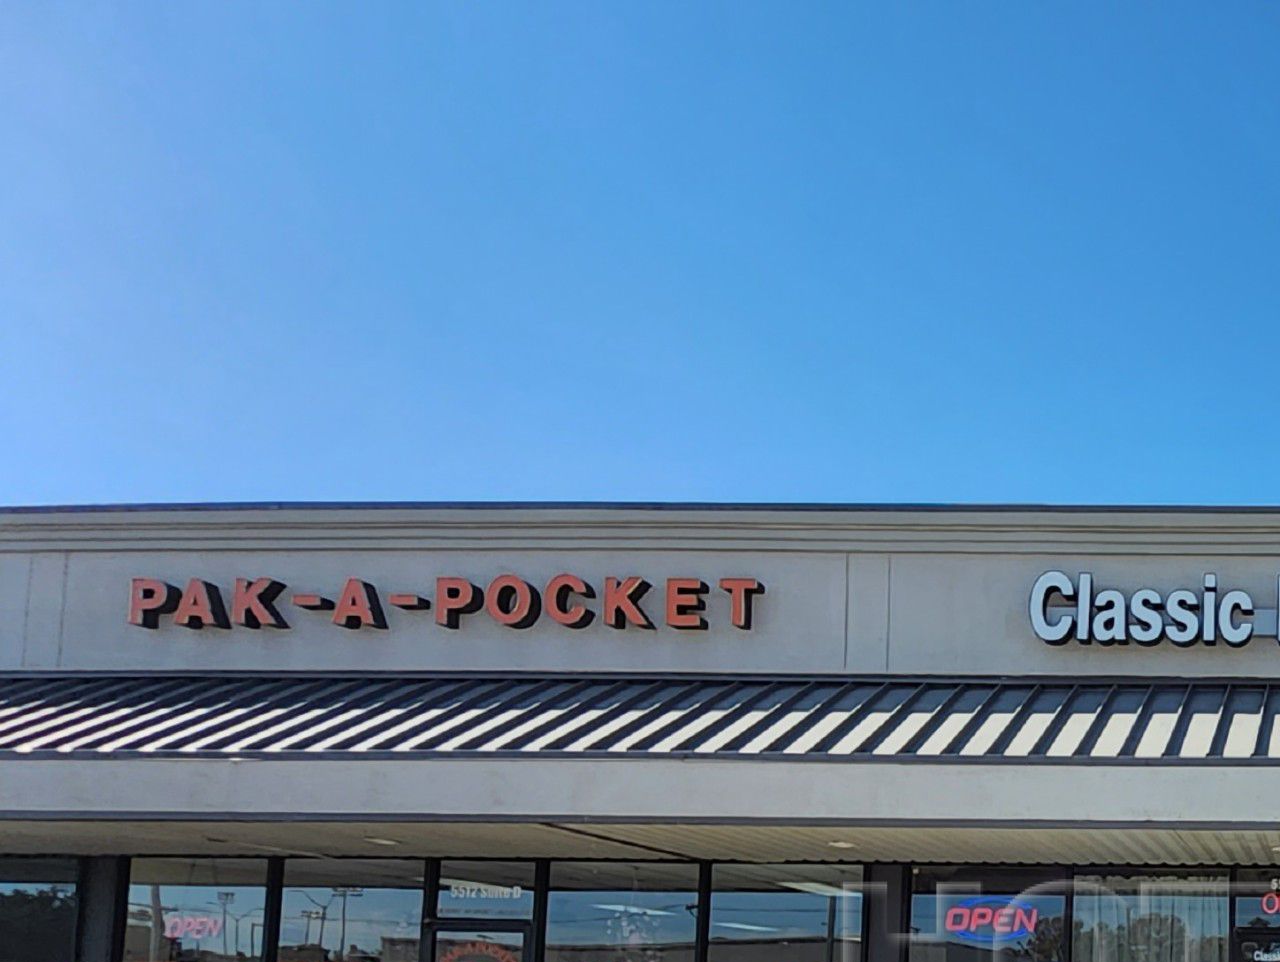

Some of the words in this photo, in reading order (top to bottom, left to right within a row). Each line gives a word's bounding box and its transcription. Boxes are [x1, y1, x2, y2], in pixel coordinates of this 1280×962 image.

[129, 574, 766, 630] PAK-A-POCKET
[1029, 570, 1254, 646] Classic
[162, 911, 223, 938] OPEN
[945, 906, 1038, 933] OPEN
